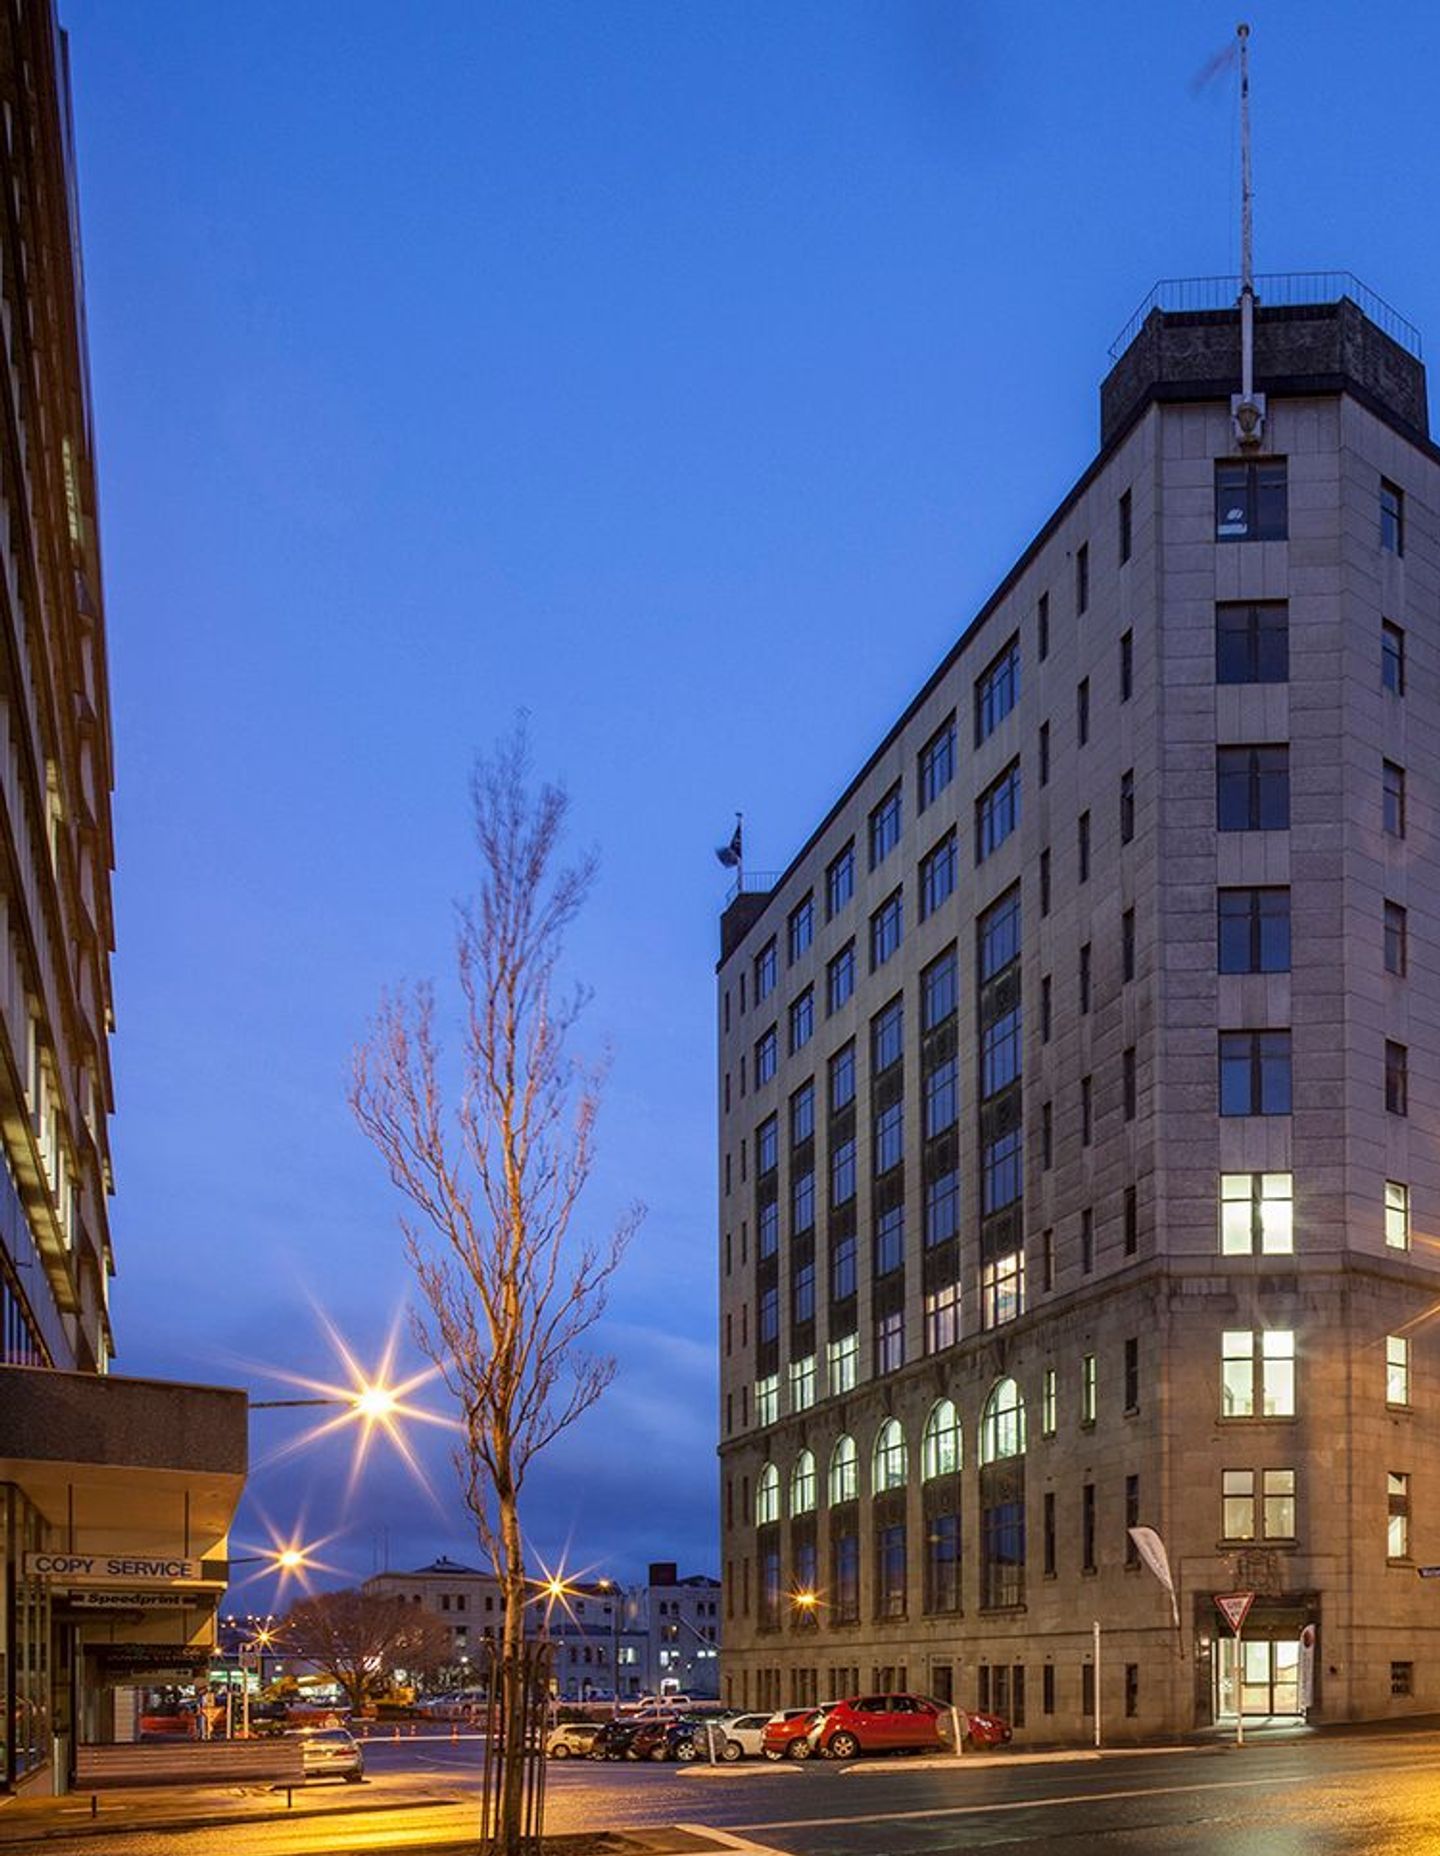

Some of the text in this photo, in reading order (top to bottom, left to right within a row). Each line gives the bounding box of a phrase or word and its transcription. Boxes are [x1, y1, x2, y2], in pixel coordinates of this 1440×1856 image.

[36, 1556, 193, 1577] COPY SERVICE
[88, 1593, 180, 1606] Speedprint
